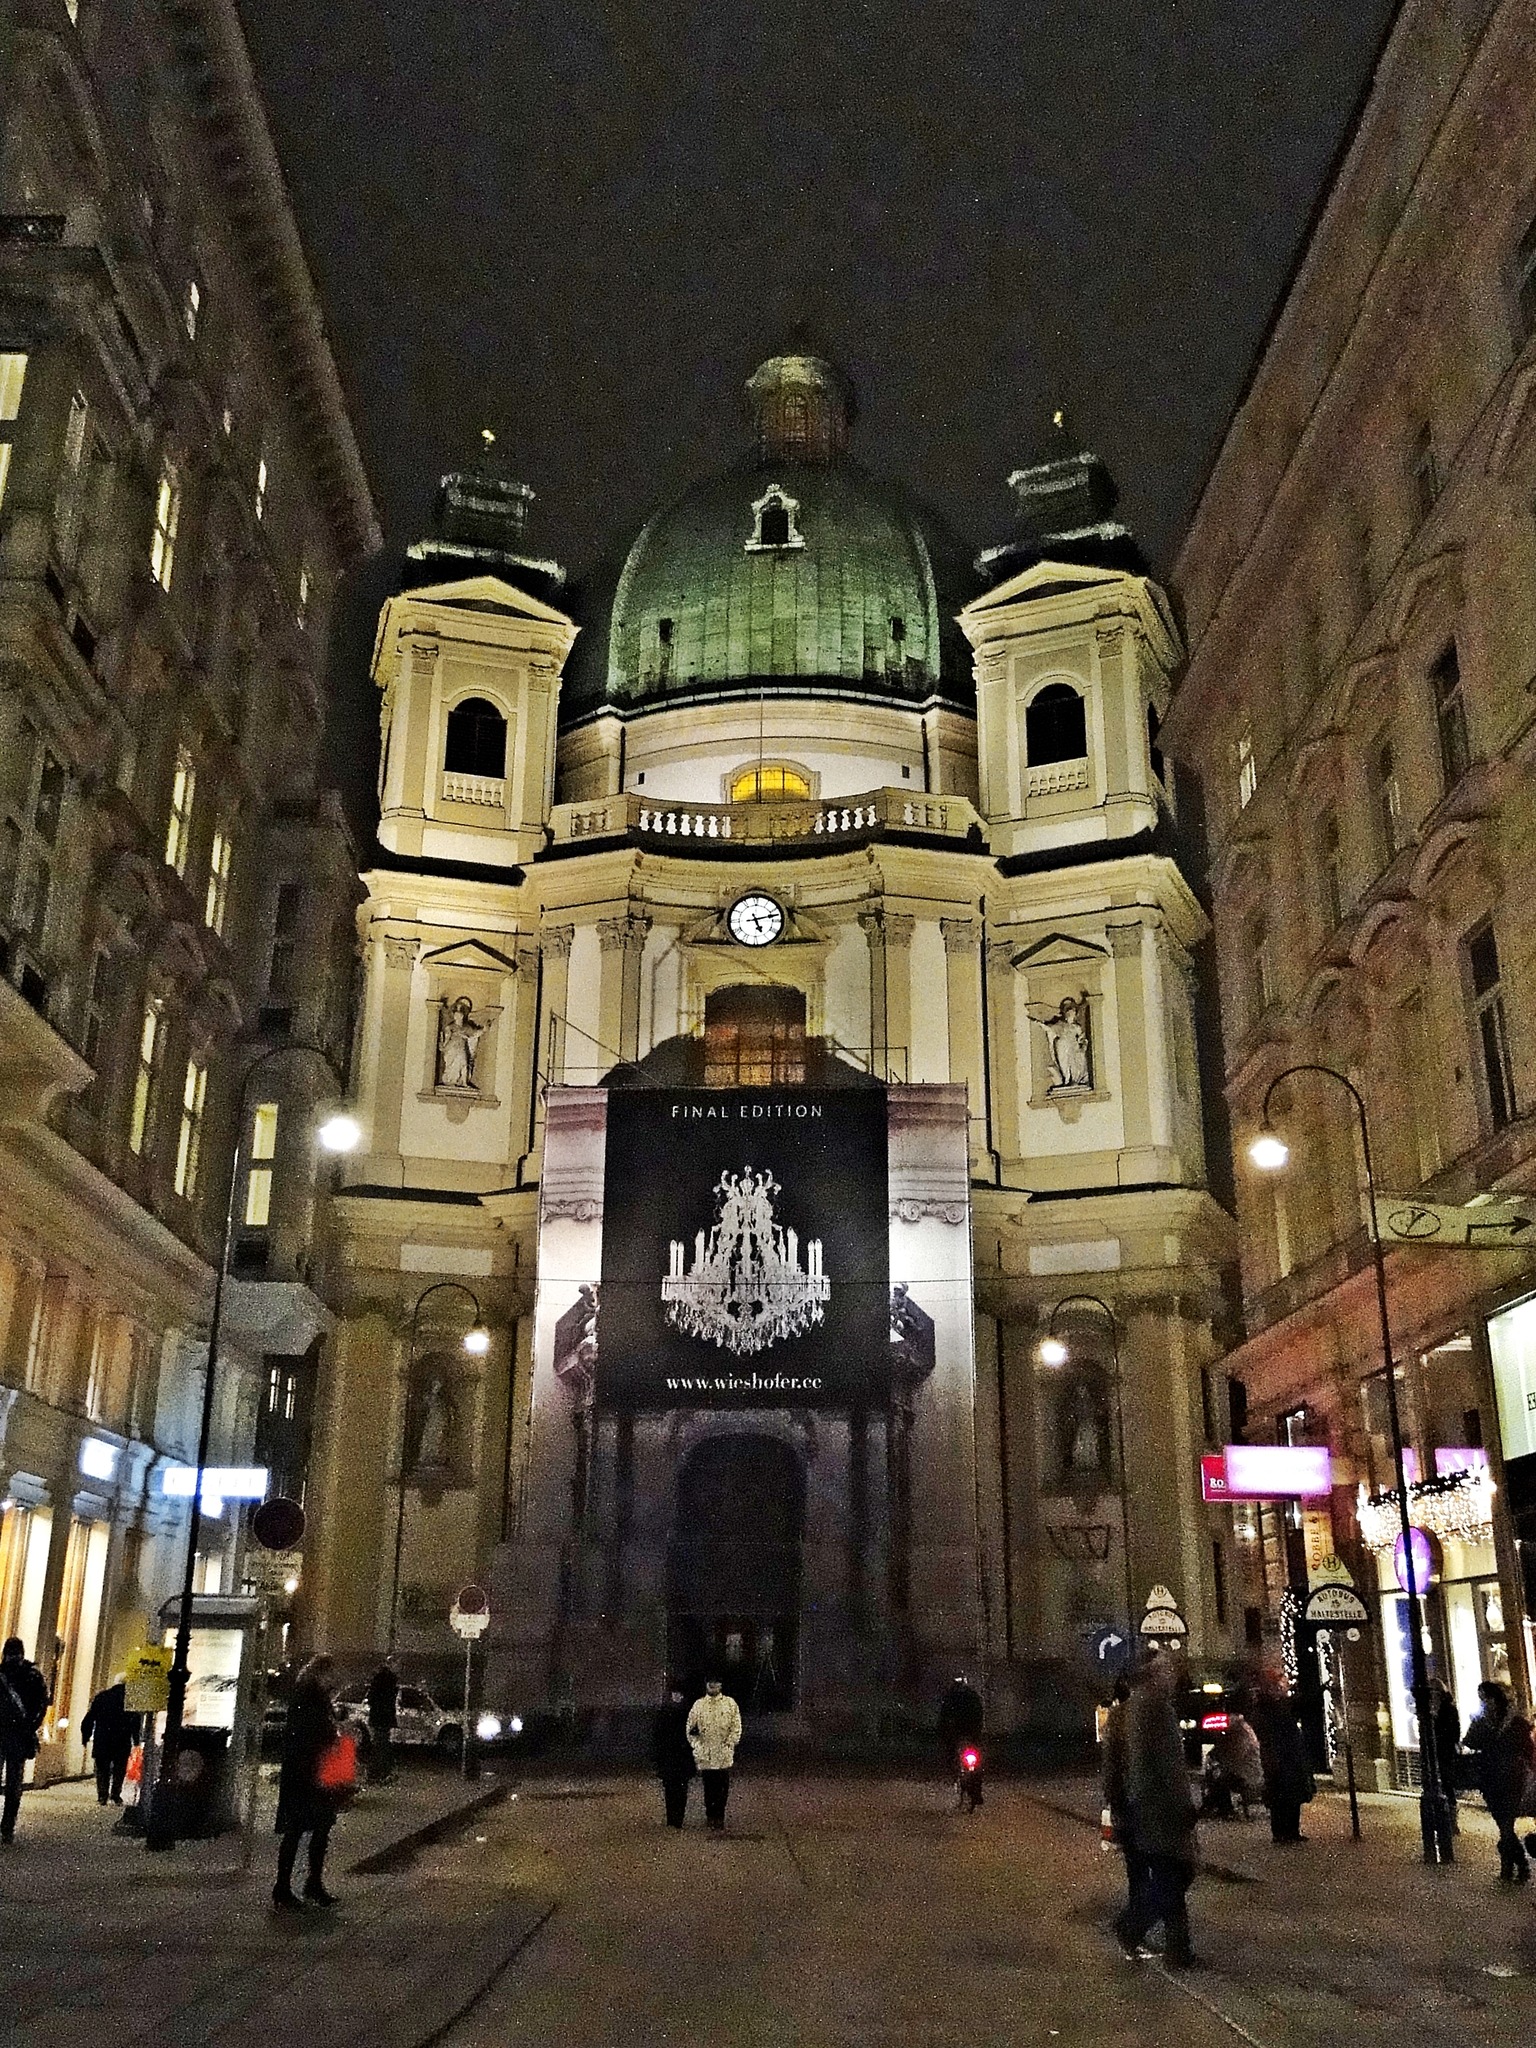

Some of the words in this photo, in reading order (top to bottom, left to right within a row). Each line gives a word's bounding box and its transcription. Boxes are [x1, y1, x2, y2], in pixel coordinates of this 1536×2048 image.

[671, 1105, 730, 1118] FINAL
[740, 1104, 823, 1118] EDITION
[666, 1373, 821, 1390] www.wieshofer.cc
[1311, 1610, 1361, 1618] HALTESTELLE
